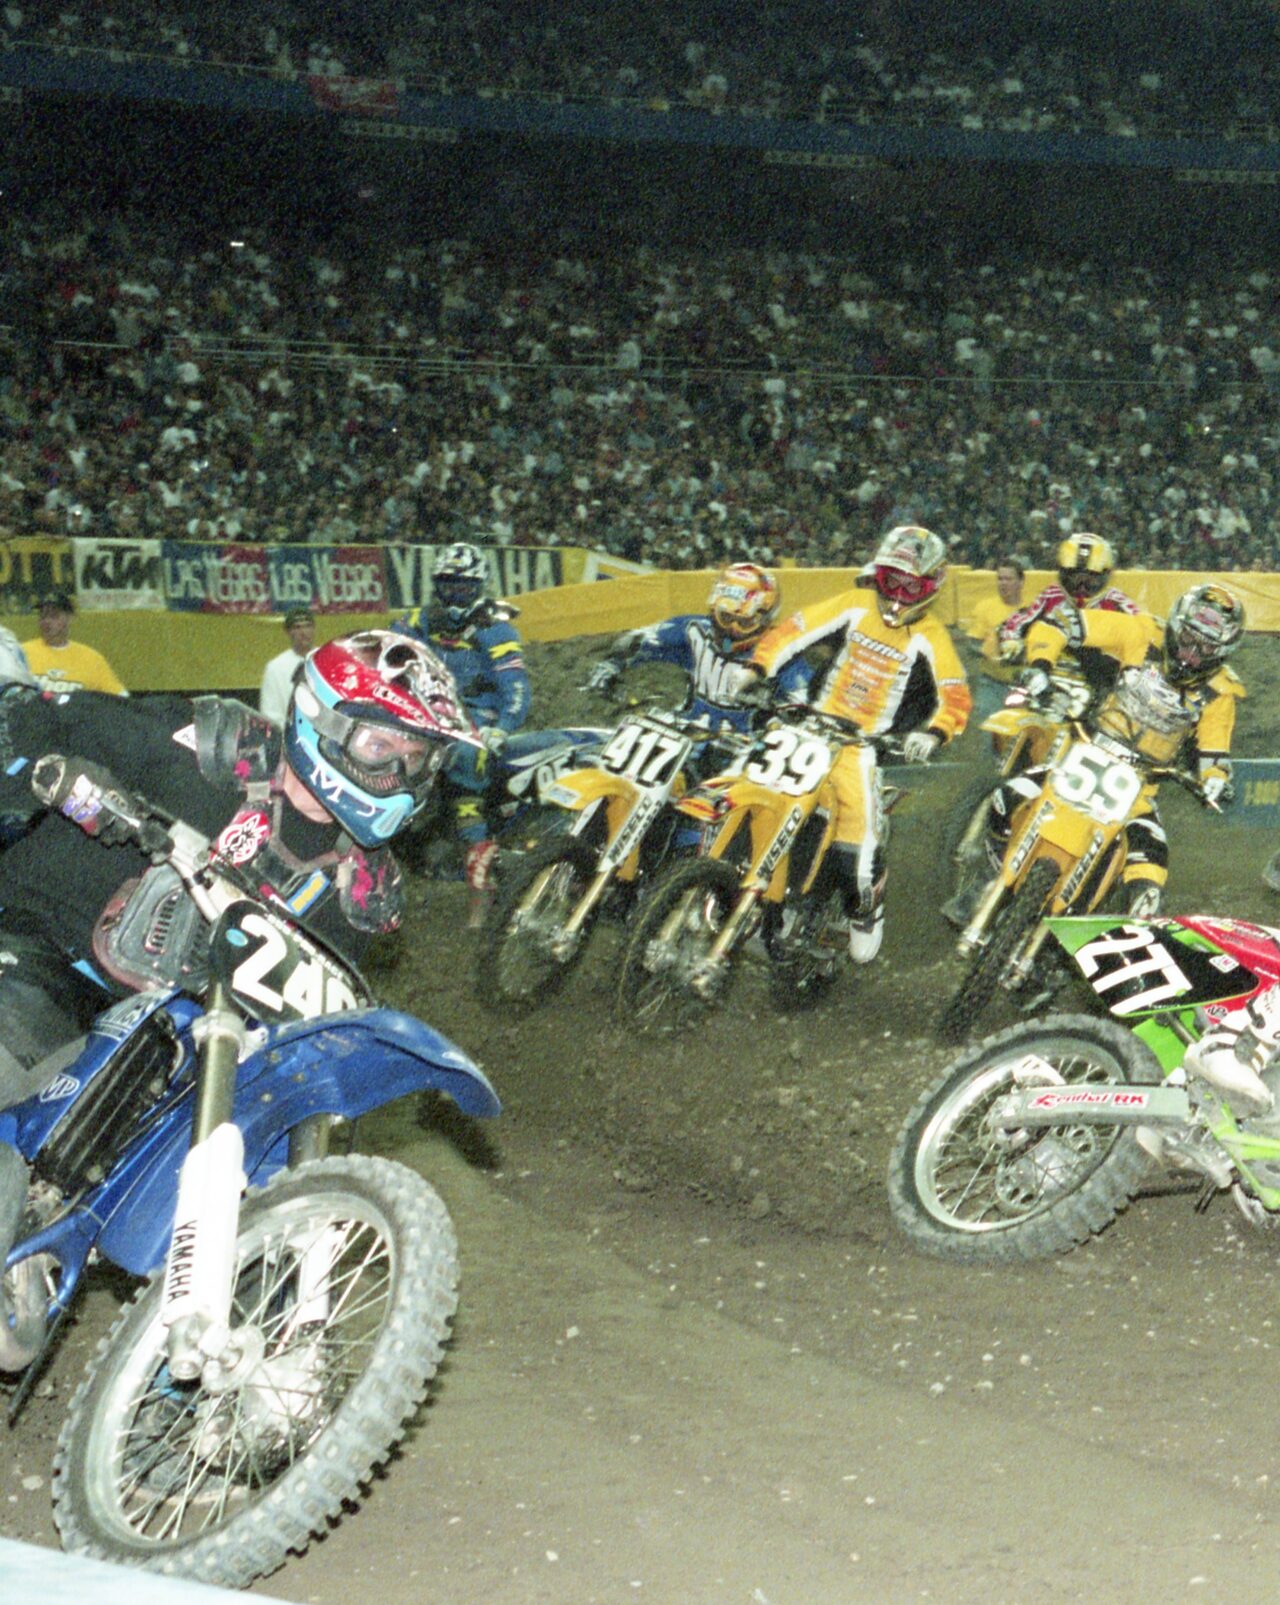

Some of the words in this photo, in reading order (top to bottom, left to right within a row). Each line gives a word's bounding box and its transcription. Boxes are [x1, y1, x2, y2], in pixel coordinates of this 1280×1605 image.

[81, 544, 161, 591] KTM
[603, 724, 685, 784] 417
[746, 730, 832, 796] 39
[1051, 743, 1143, 826] 59
[755, 805, 804, 876] WISECO
[1074, 924, 1194, 1017] 277
[1113, 1091, 1147, 1108] RK
[167, 1219, 198, 1301] YAMAHA
